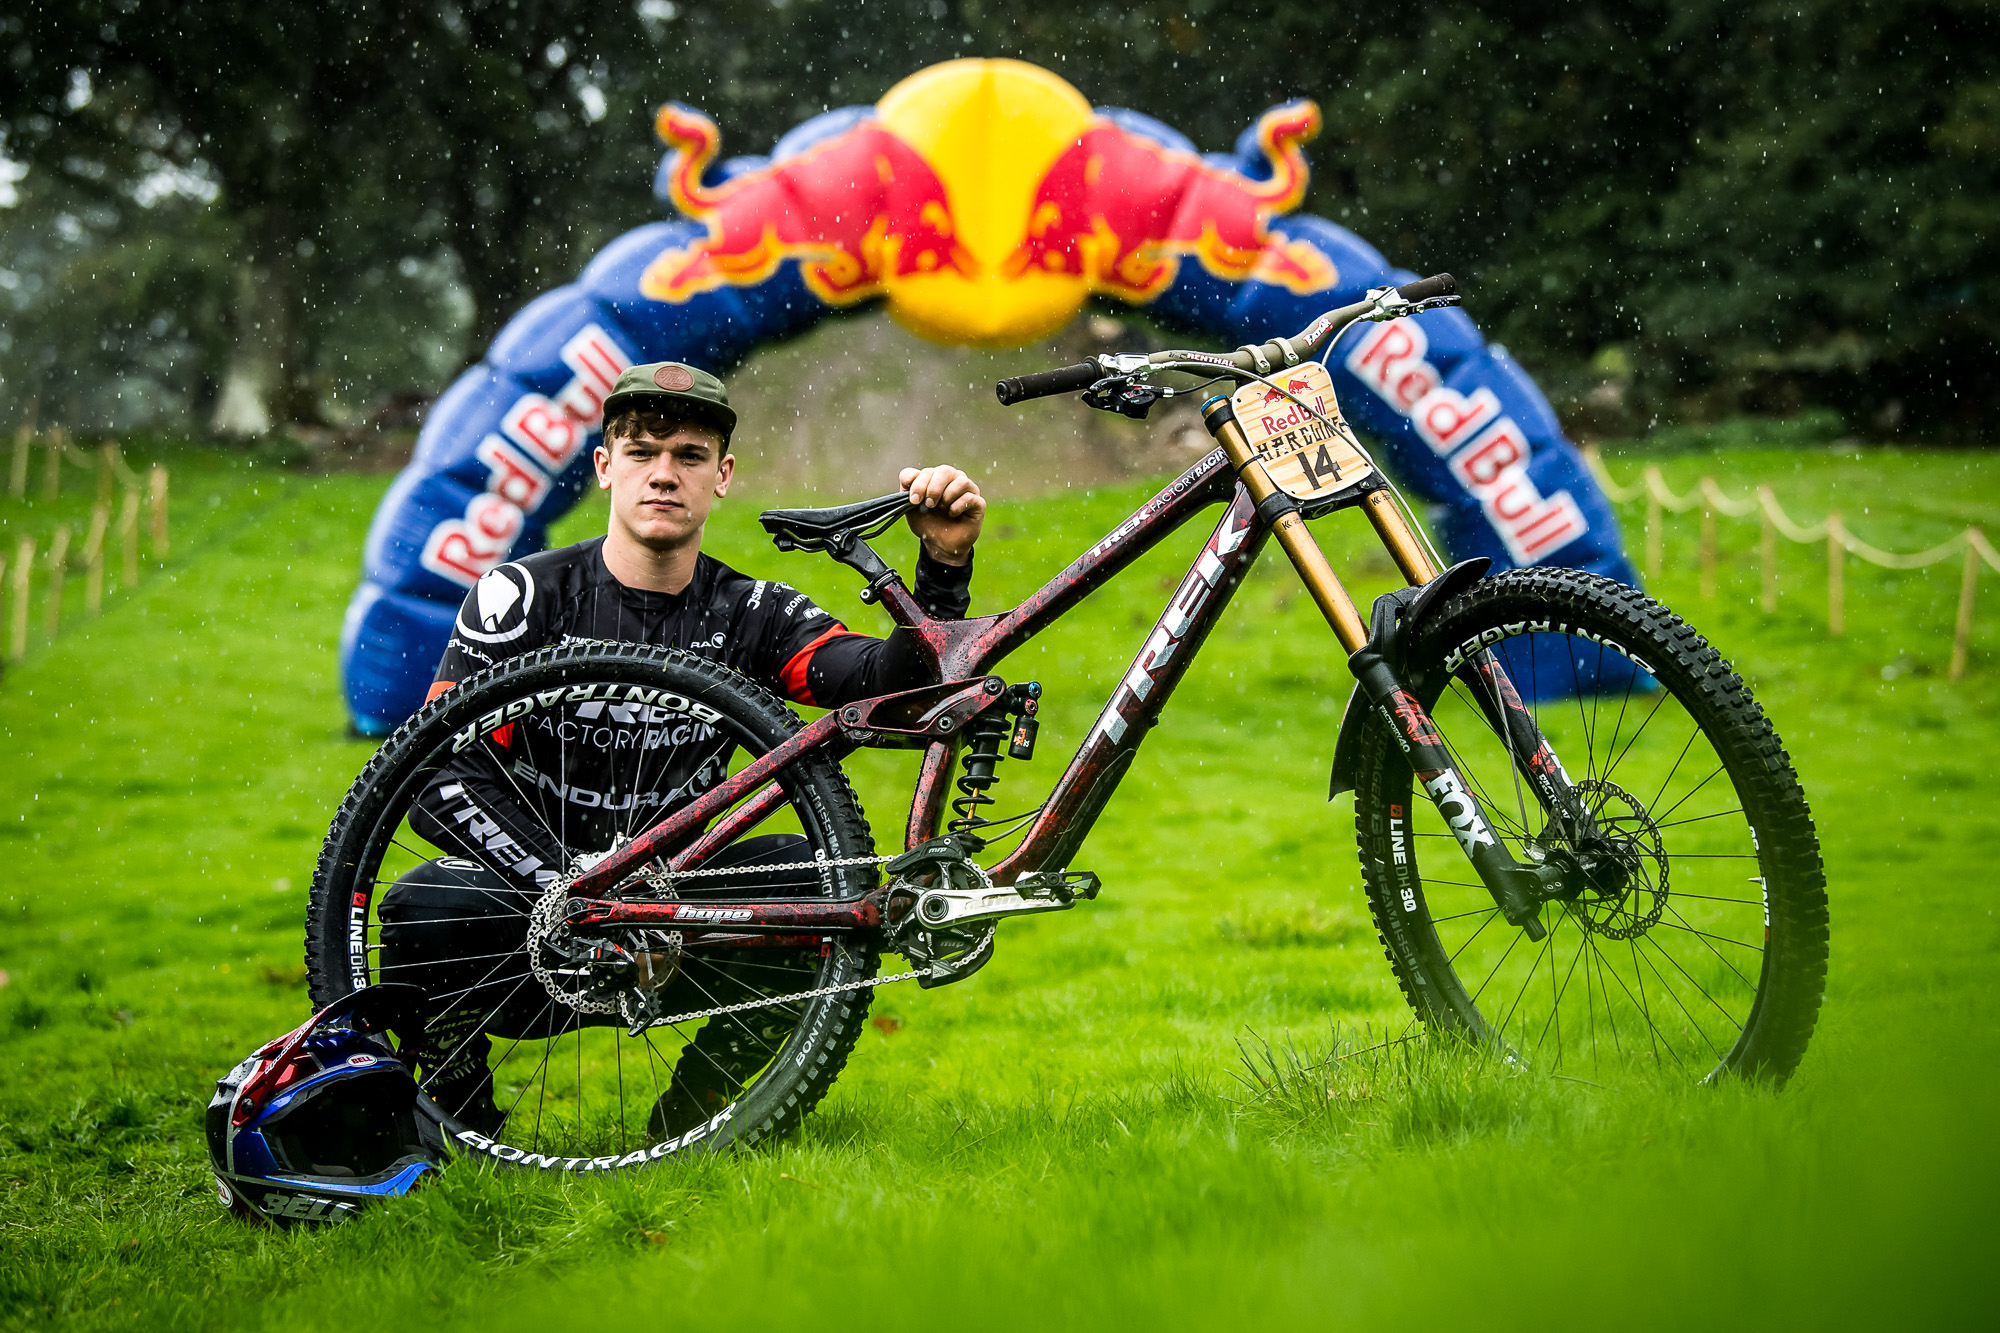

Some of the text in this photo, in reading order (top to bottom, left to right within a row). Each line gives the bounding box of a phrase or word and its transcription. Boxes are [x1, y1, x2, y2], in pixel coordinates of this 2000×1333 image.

[1186, 352, 1235, 368] RENTHAL
[1261, 395, 1328, 436] Red Bull
[1357, 320, 1577, 557] Red Bull
[432, 336, 626, 582] Red Bull
[1296, 443, 1342, 491] 14
[1088, 449, 1227, 558] TREK FACTORY RACIN
[1088, 506, 1251, 749] TREK
[452, 683, 724, 754] BONTRAGER
[529, 714, 723, 751] ACTORY RACIN
[513, 758, 688, 811] ENDURA
[1425, 767, 1496, 859] FOX
[673, 904, 754, 925] hope
[350, 1055, 374, 1065] BELL
[455, 1101, 737, 1171] BONTRAGER
[259, 1192, 357, 1223] BELL
